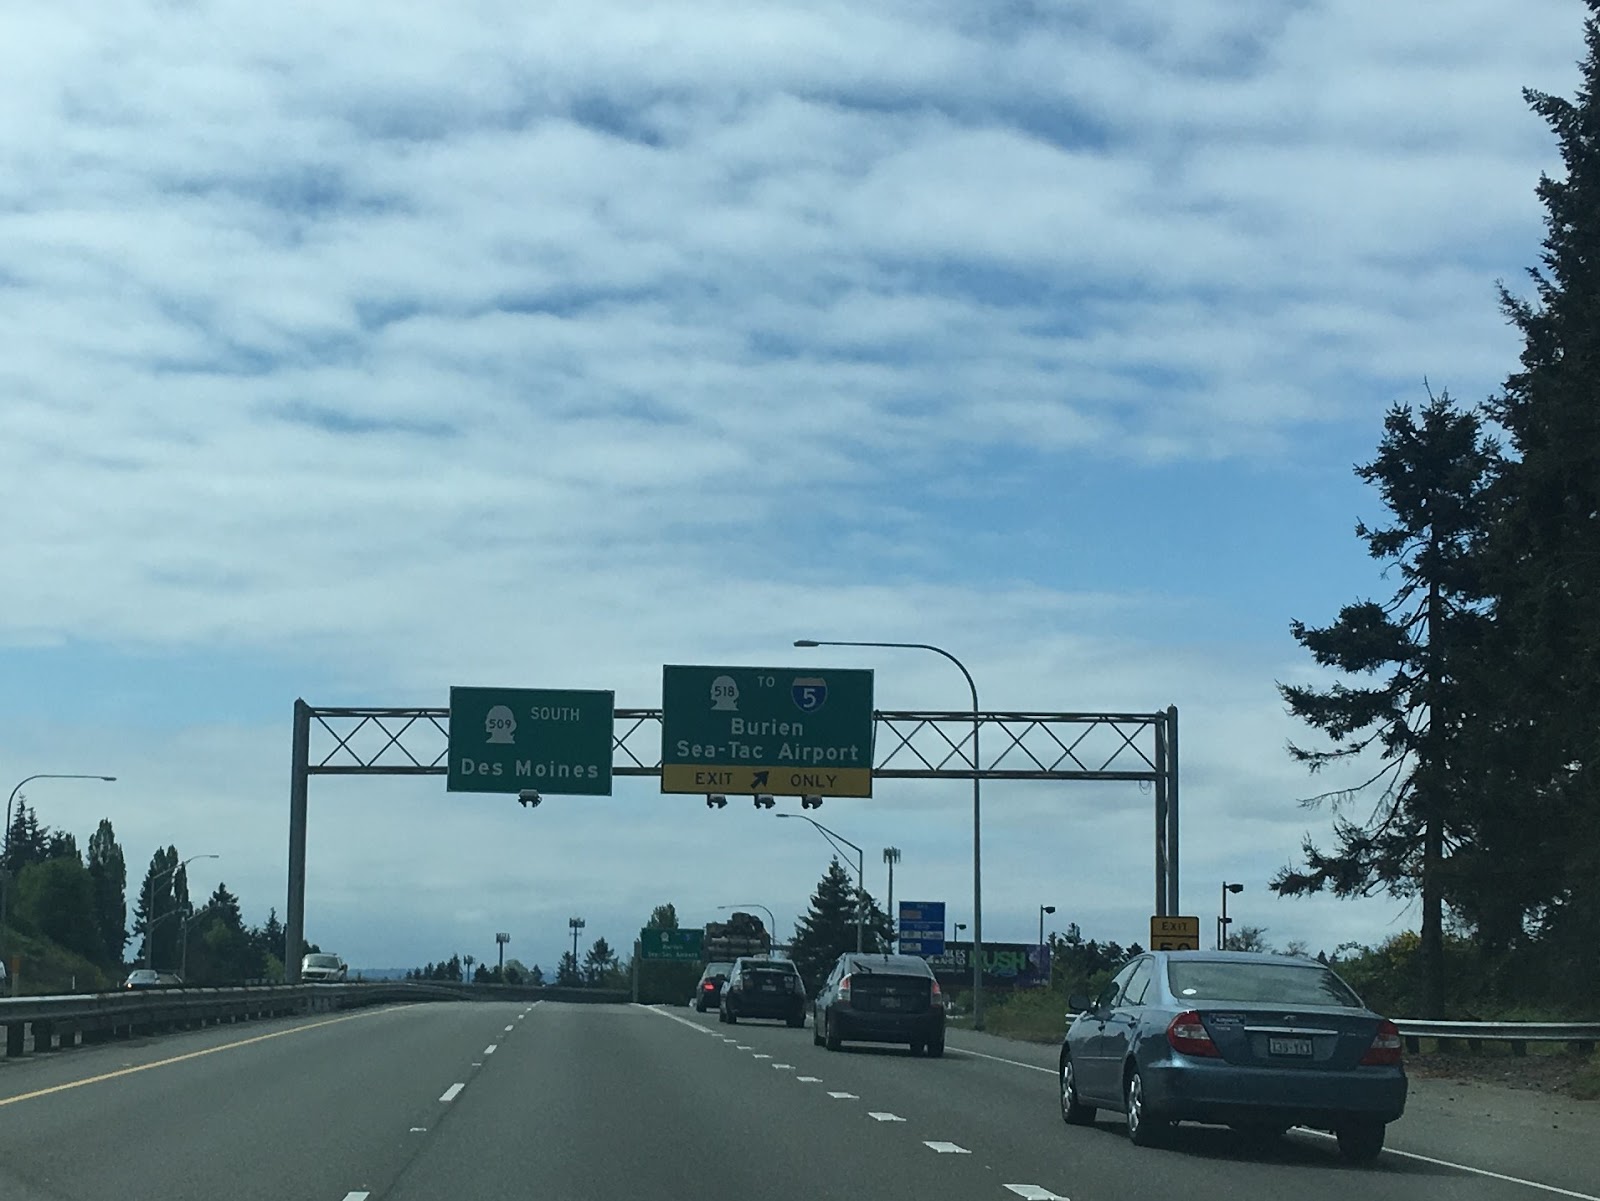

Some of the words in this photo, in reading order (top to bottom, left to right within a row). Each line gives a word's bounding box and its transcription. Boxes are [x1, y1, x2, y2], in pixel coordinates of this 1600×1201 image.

[757, 676, 775, 688] TO
[714, 686, 735, 698] 518
[803, 688, 817, 708] 5
[530, 707, 580, 721] SOUTH
[489, 719, 512, 729] 509
[731, 718, 803, 736] Burien
[676, 740, 763, 759] Sea-Tac
[778, 743, 859, 764] Airport
[461, 757, 503, 775] Des
[515, 760, 598, 778] Moines
[695, 772, 733, 785] EXIT
[790, 774, 837, 788] ONLY
[1161, 921, 1187, 931] EXIT
